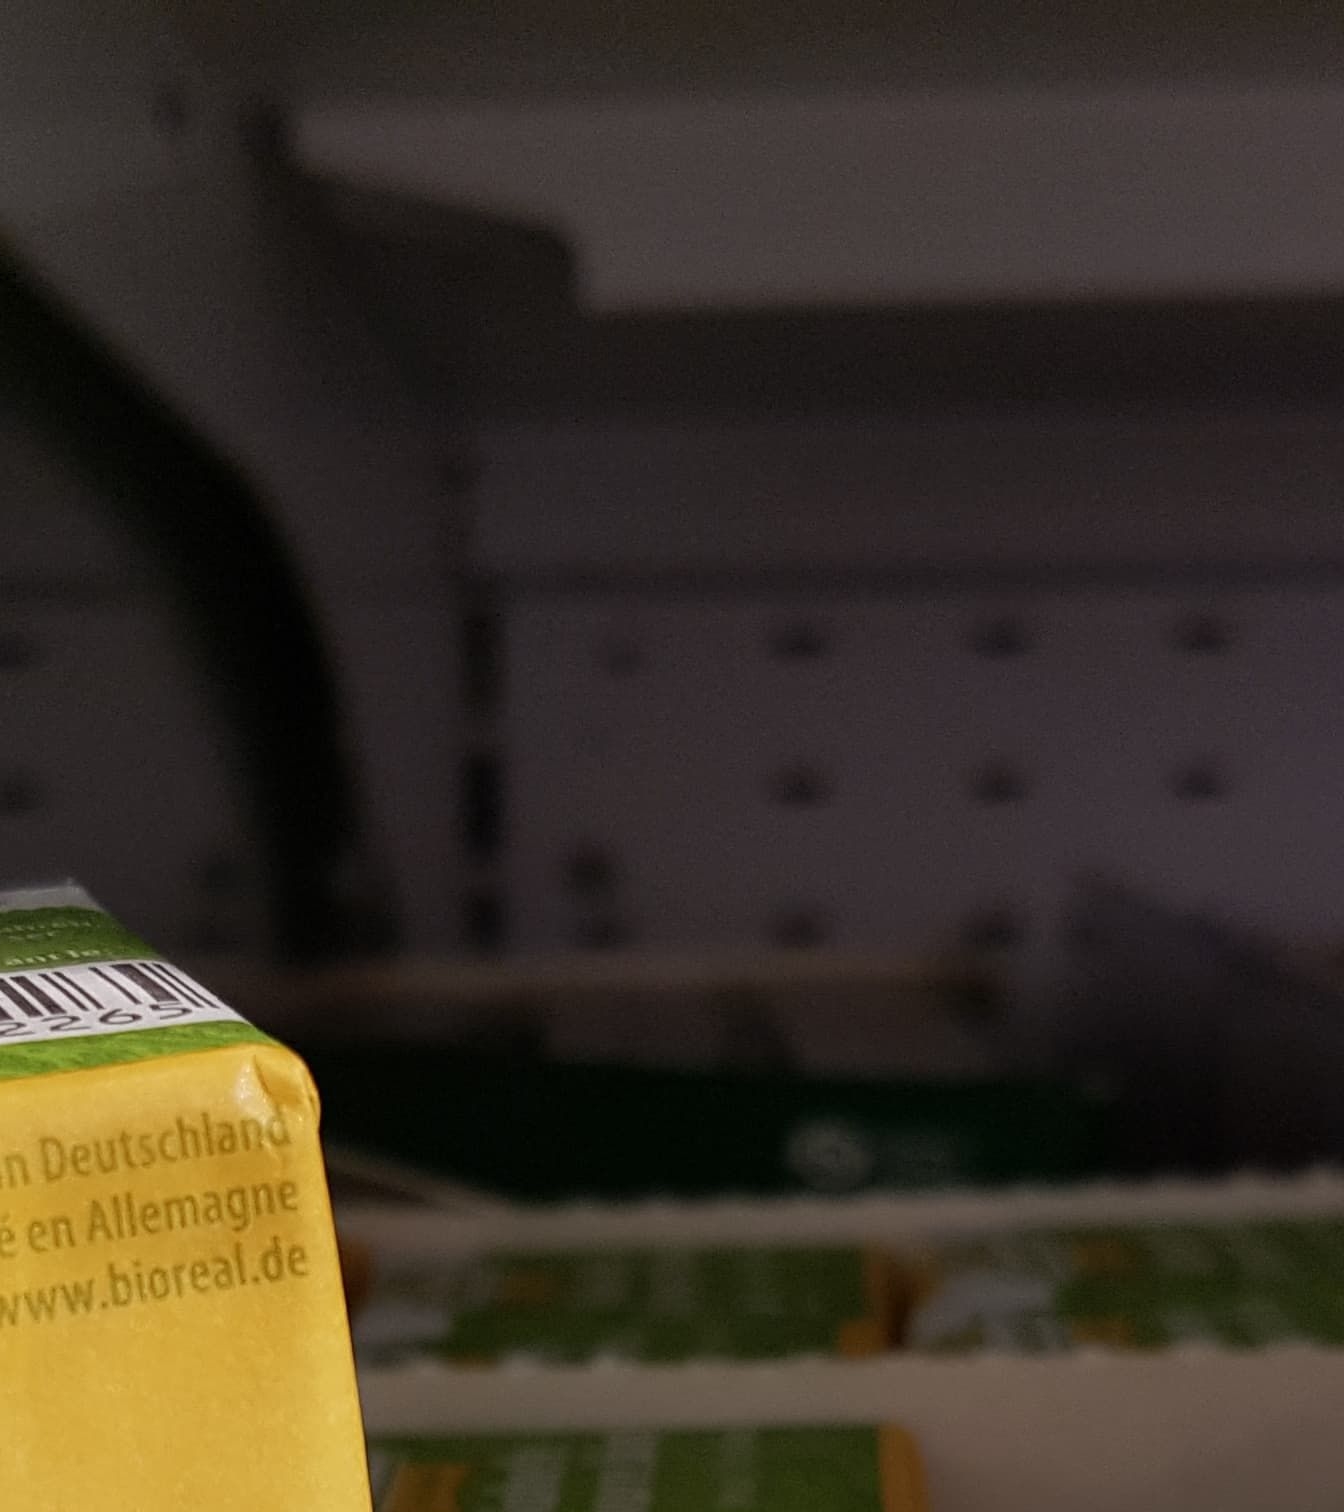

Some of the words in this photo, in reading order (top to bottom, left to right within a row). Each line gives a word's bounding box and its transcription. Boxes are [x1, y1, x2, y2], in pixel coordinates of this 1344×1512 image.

[39, 1108, 293, 1184] Deutschland
[27, 1212, 77, 1254] en
[85, 1176, 299, 1243] Allemagne
